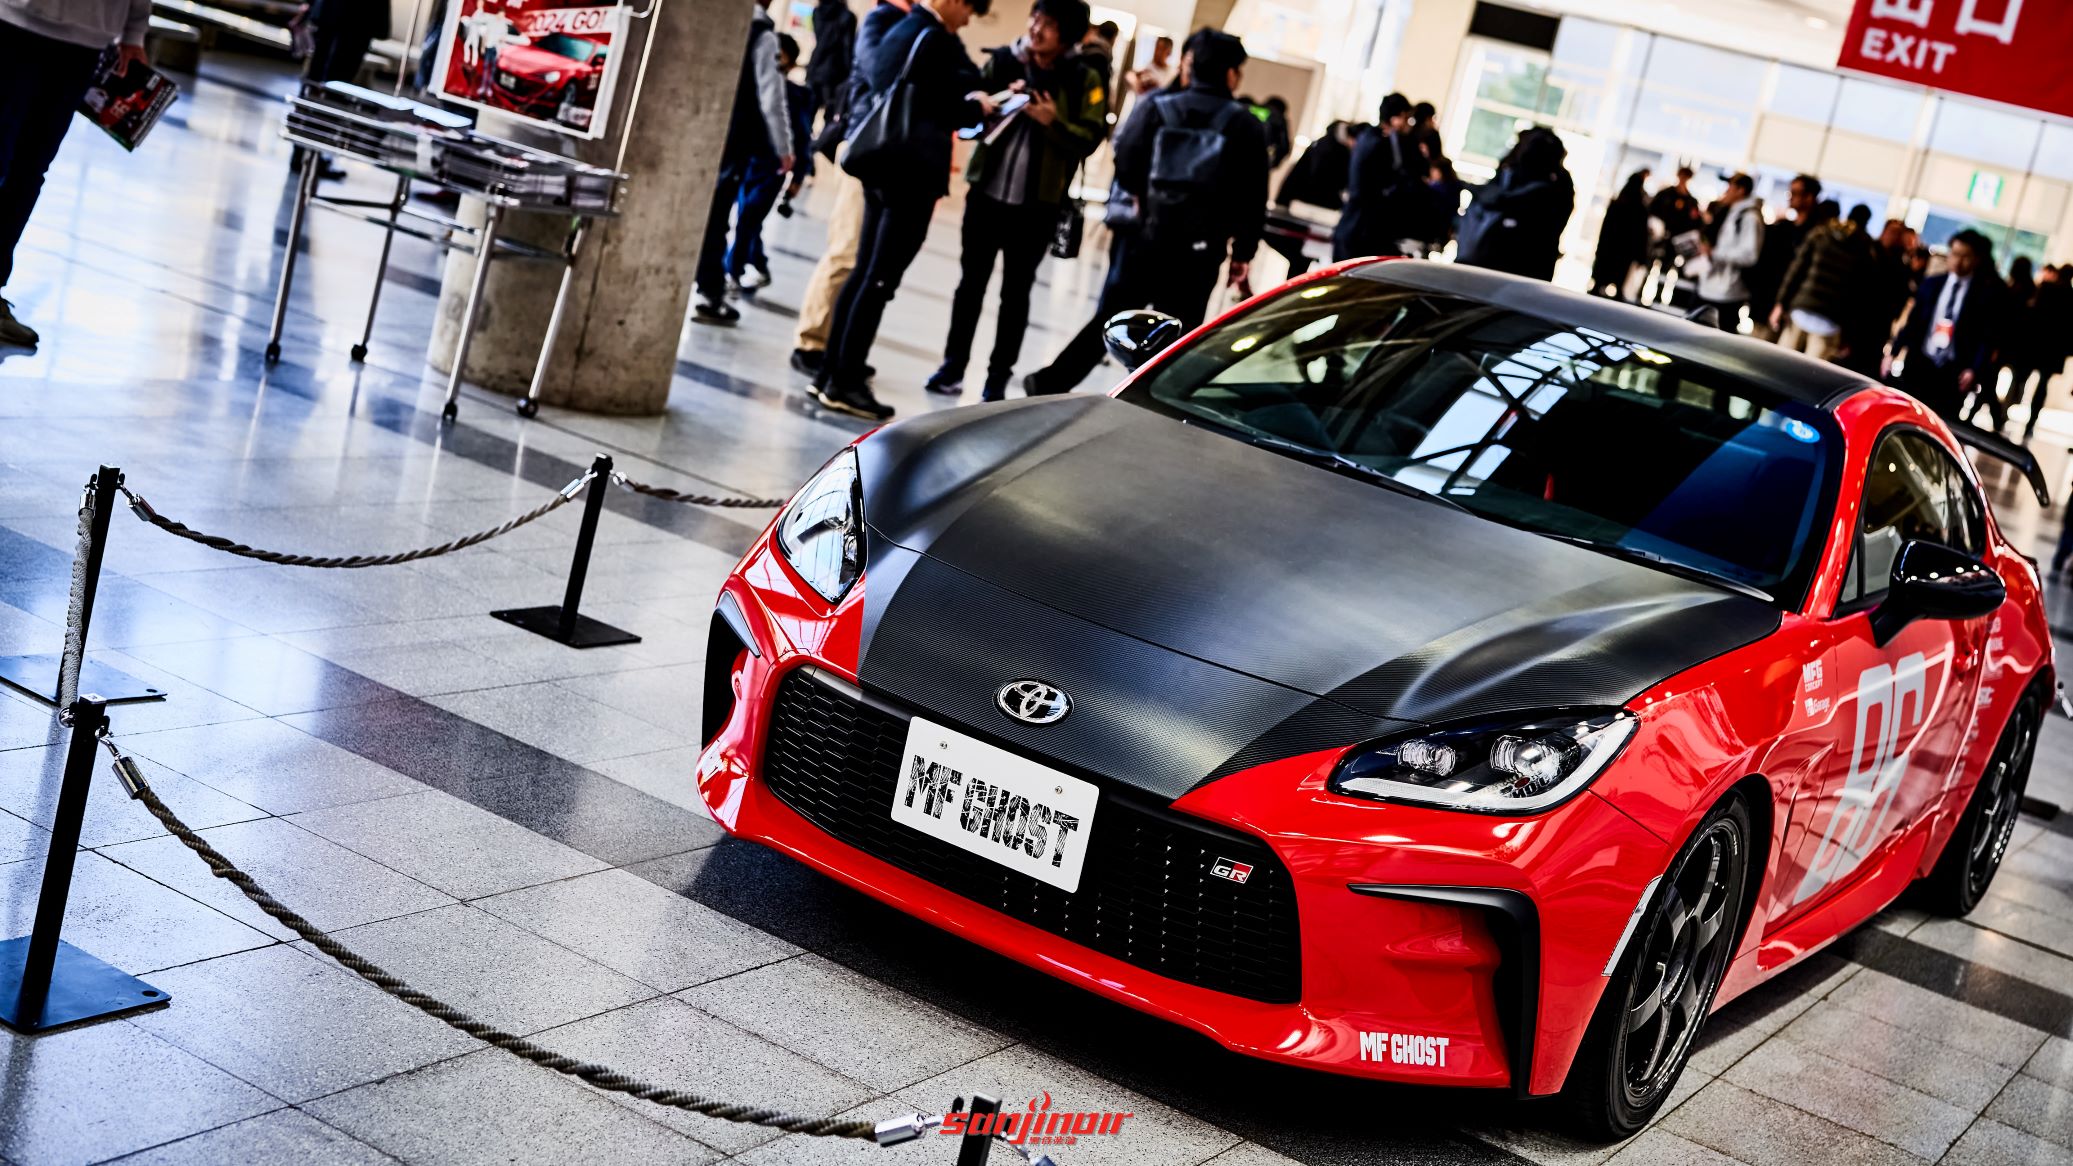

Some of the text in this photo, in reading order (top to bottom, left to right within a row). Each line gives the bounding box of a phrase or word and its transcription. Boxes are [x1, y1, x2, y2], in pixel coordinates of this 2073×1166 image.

[1860, 27, 1957, 73] EXIT
[1802, 659, 1823, 684] MFG
[904, 754, 1080, 868] MF GHOST
[1213, 865, 1248, 882] GR
[1359, 1031, 1450, 1067] MF GHOST
